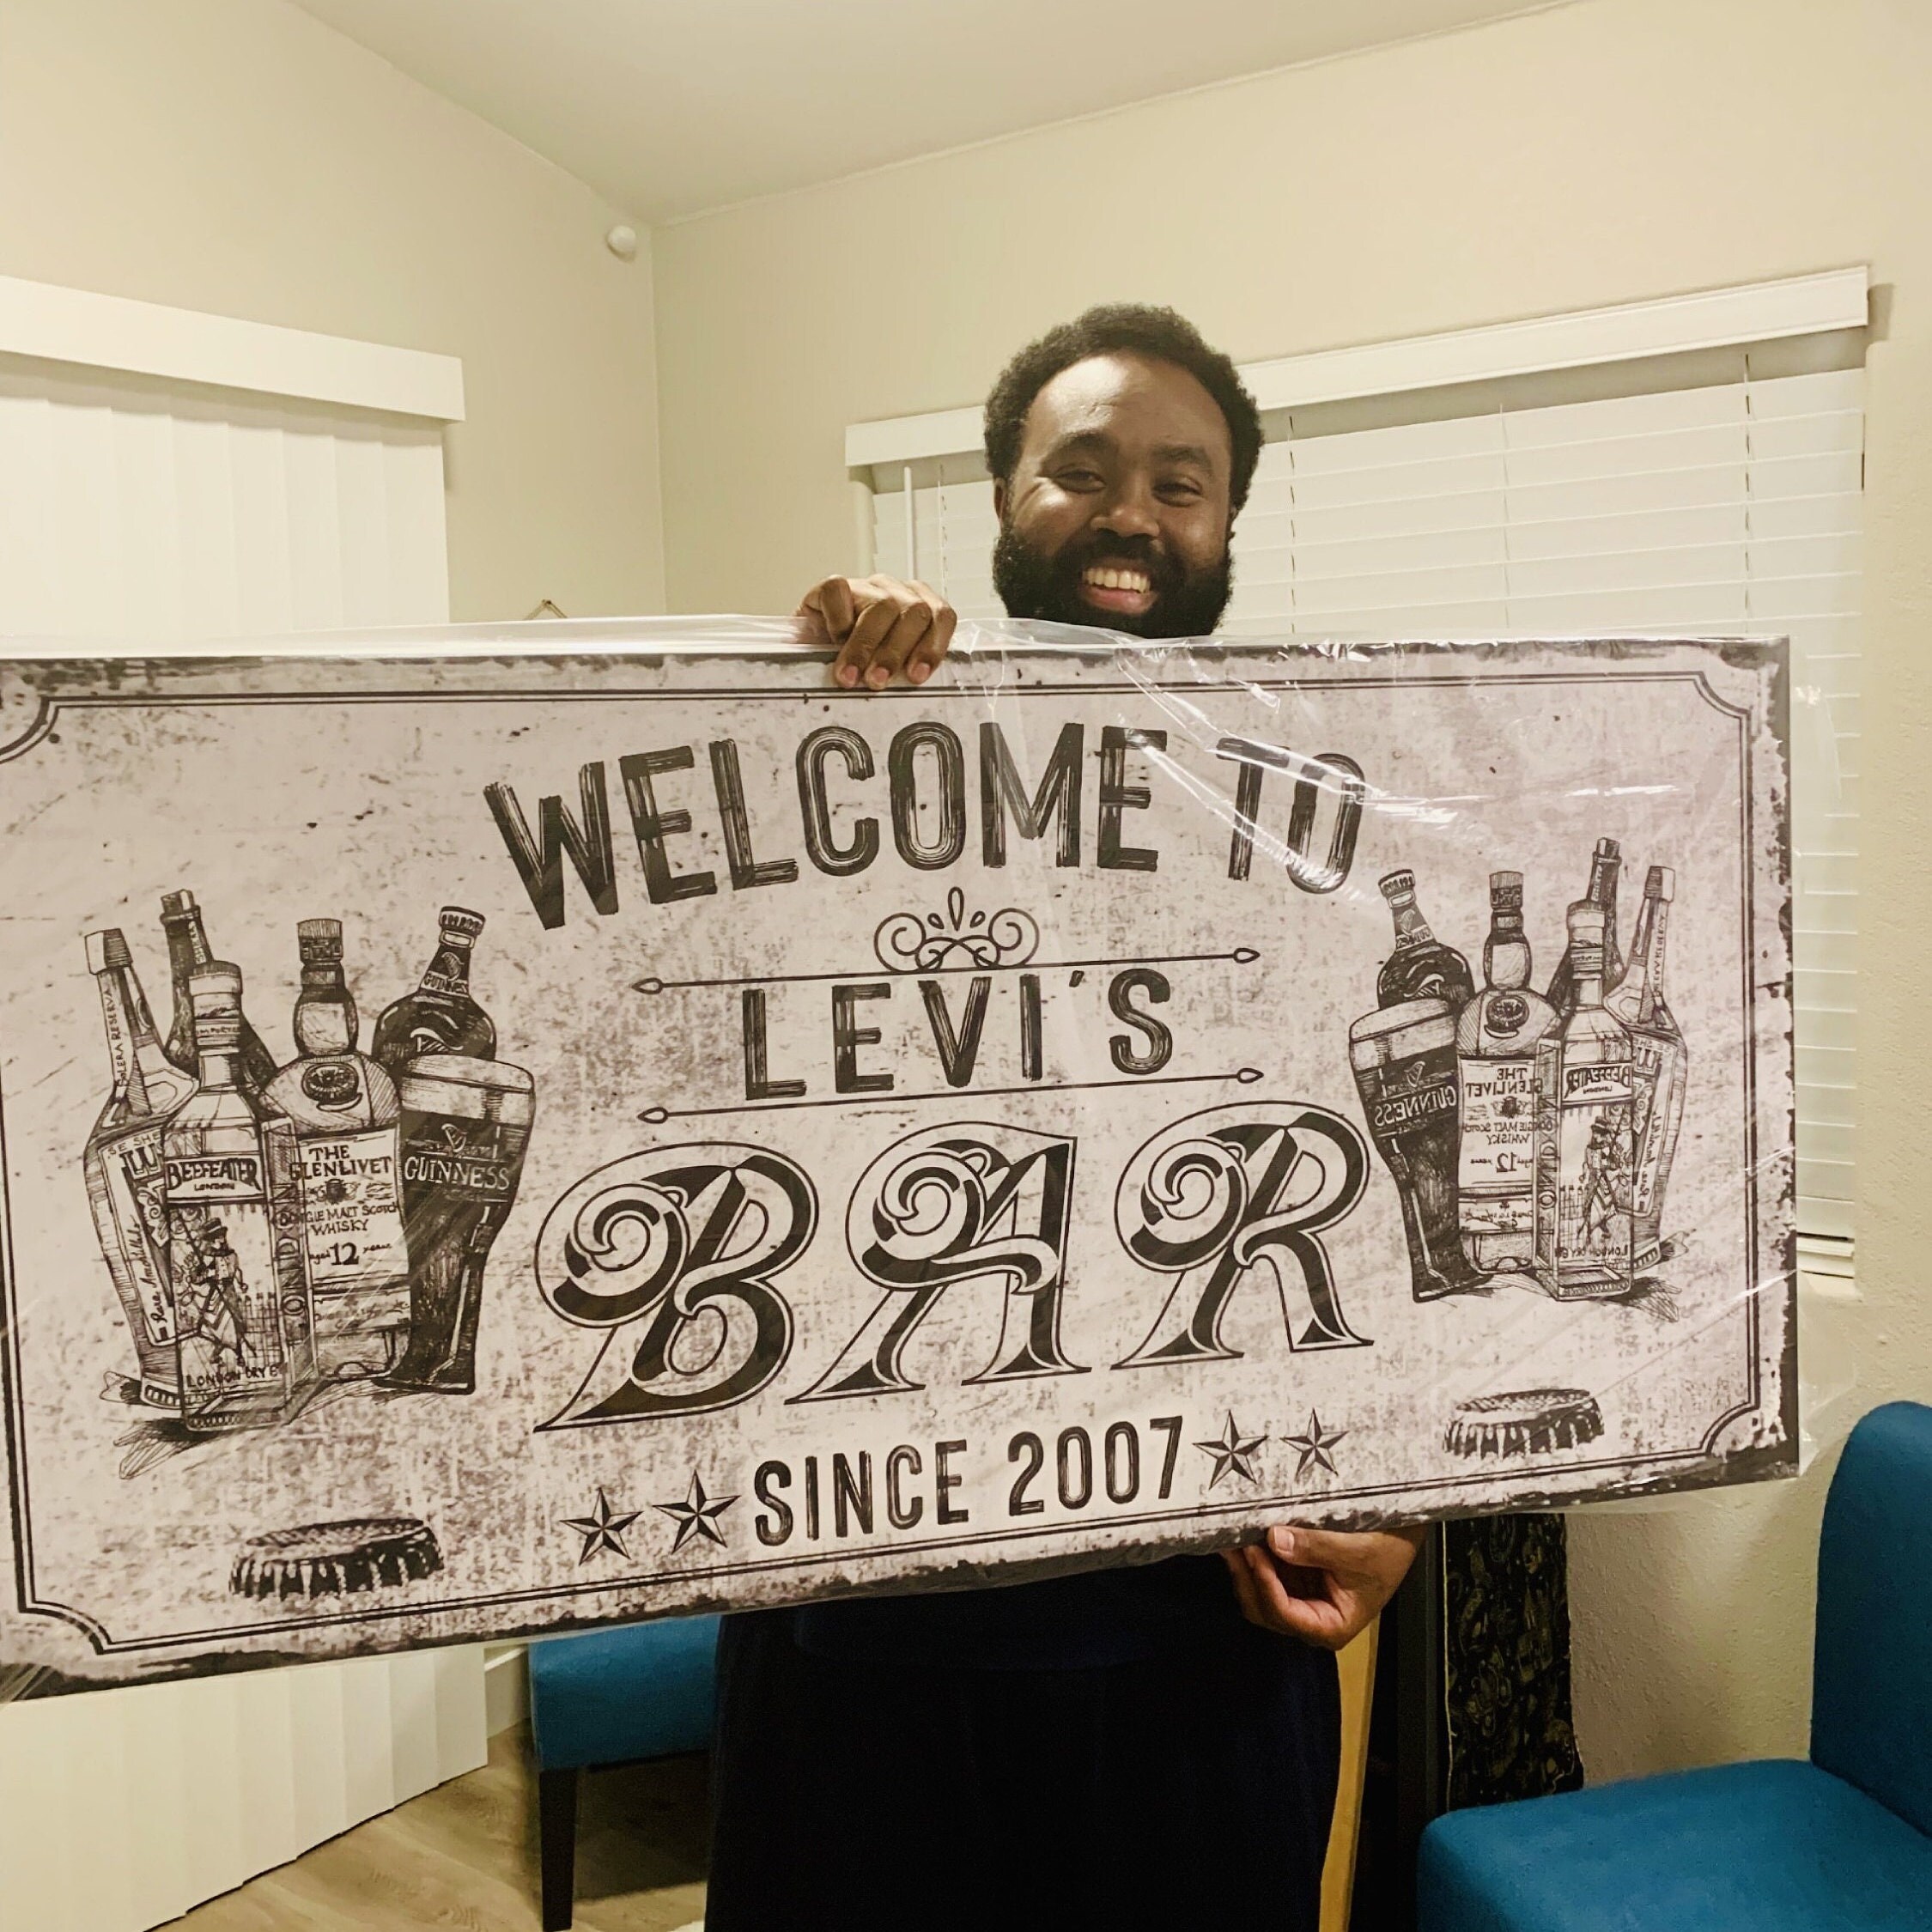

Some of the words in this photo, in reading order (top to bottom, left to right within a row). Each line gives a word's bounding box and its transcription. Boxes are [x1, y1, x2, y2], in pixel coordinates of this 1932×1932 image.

[483, 721, 1167, 929] WELCOME
[1214, 737, 1366, 893] TO
[741, 967, 1174, 1100] LEVI'S
[289, 1156, 392, 1181] GLENLIVET
[308, 1145, 350, 1161] THE
[165, 1157, 262, 1191] BEEFEATER
[404, 1156, 510, 1190] GUINNESS
[310, 1219, 368, 1236] WHISKY
[326, 1206, 359, 1220] MALT
[330, 1242, 360, 1266] 12
[532, 1100, 1375, 1432] BAR
[752, 1439, 970, 1546] SINCE
[1008, 1416, 1184, 1516] 2007
